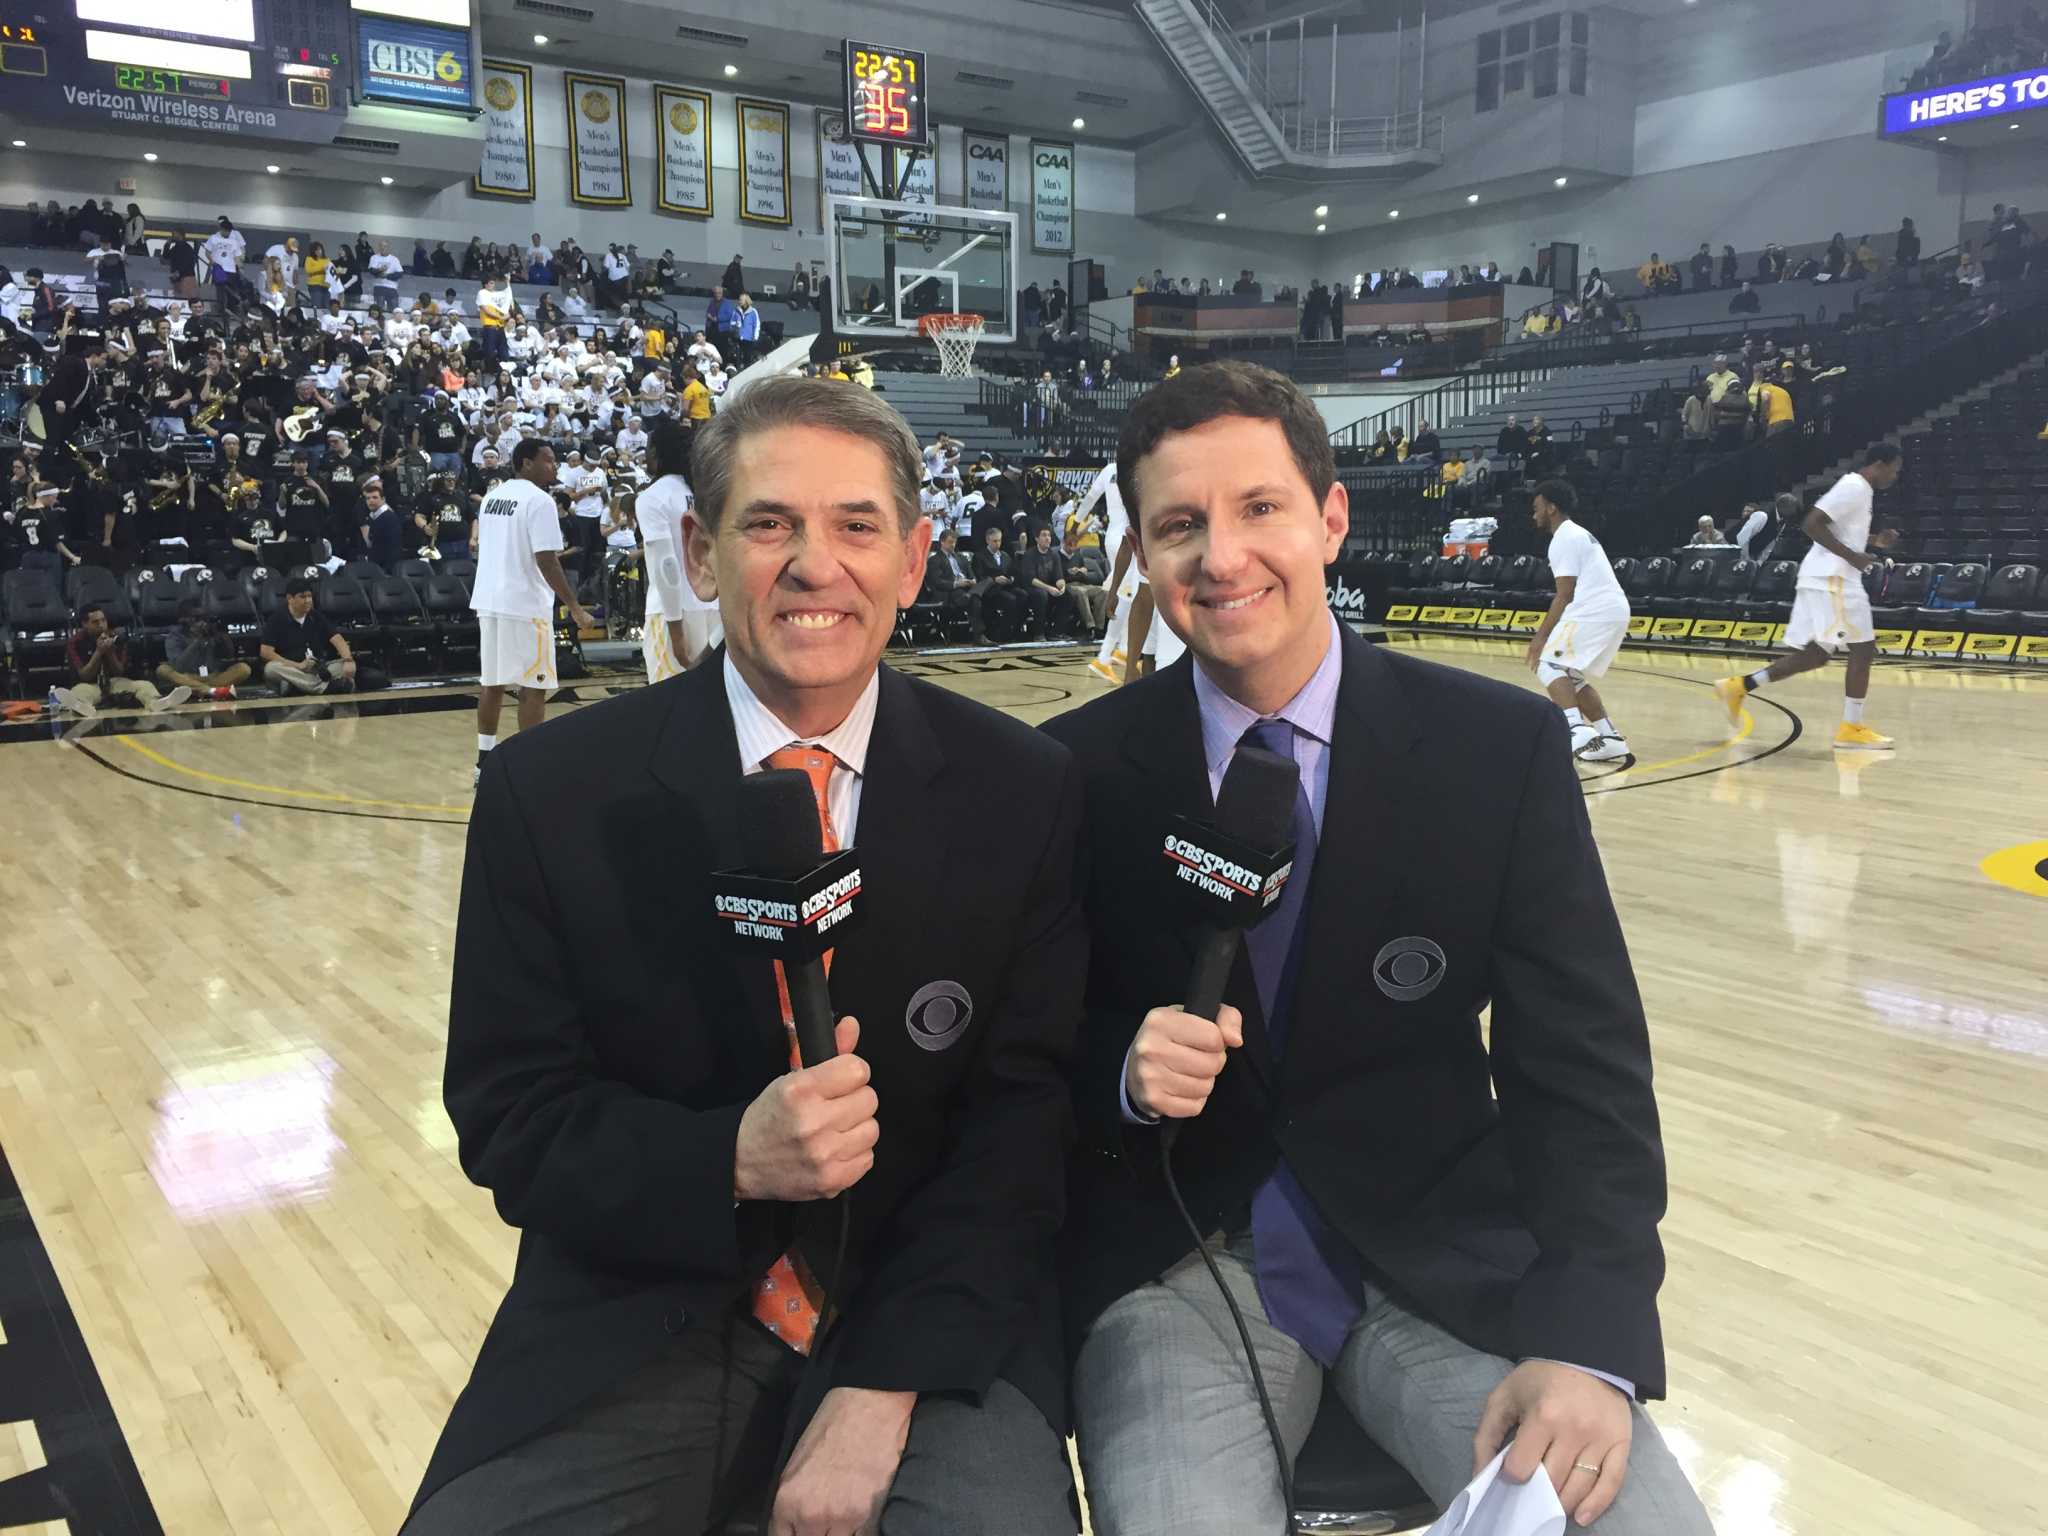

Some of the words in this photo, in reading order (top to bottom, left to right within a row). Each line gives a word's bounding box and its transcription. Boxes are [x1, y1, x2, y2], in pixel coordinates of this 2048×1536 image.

[372, 42, 431, 77] CBS
[436, 50, 462, 82] 6
[313, 86, 324, 104] 0
[1909, 83, 2006, 123] HERE'S
[2012, 74, 2048, 103] TO
[63, 85, 136, 110] Verizon
[140, 94, 219, 121] Wireless
[224, 104, 277, 127] Arena
[864, 83, 909, 132] 35
[111, 110, 150, 122] STUART
[152, 114, 163, 123] C.
[164, 116, 199, 128] SIEGEL
[202, 120, 240, 132] CENTER
[485, 135, 525, 147] asketball
[585, 129, 611, 141] Men's
[673, 140, 696, 152] Men's
[970, 143, 1004, 163] CAA
[830, 149, 852, 163] Men's
[1036, 152, 1069, 170] CAA
[825, 169, 860, 183] Basketball
[909, 166, 927, 178] en's
[976, 170, 996, 183] Men's
[592, 181, 610, 193] 1981
[903, 181, 934, 195] asketball
[1042, 178, 1062, 190] Men's
[676, 190, 695, 201] 1985
[970, 187, 1003, 201] Basketball
[1037, 193, 1068, 207] Basketball
[1045, 229, 1063, 243] 2012
[1056, 470, 1098, 484] ROWDY
[484, 498, 518, 516] HAVOC
[963, 501, 977, 518] 6
[1326, 575, 1365, 609] oba
[1176, 864, 1236, 902] NETWORK
[816, 899, 853, 935] NETWORK
[734, 920, 784, 942] NETWORK
